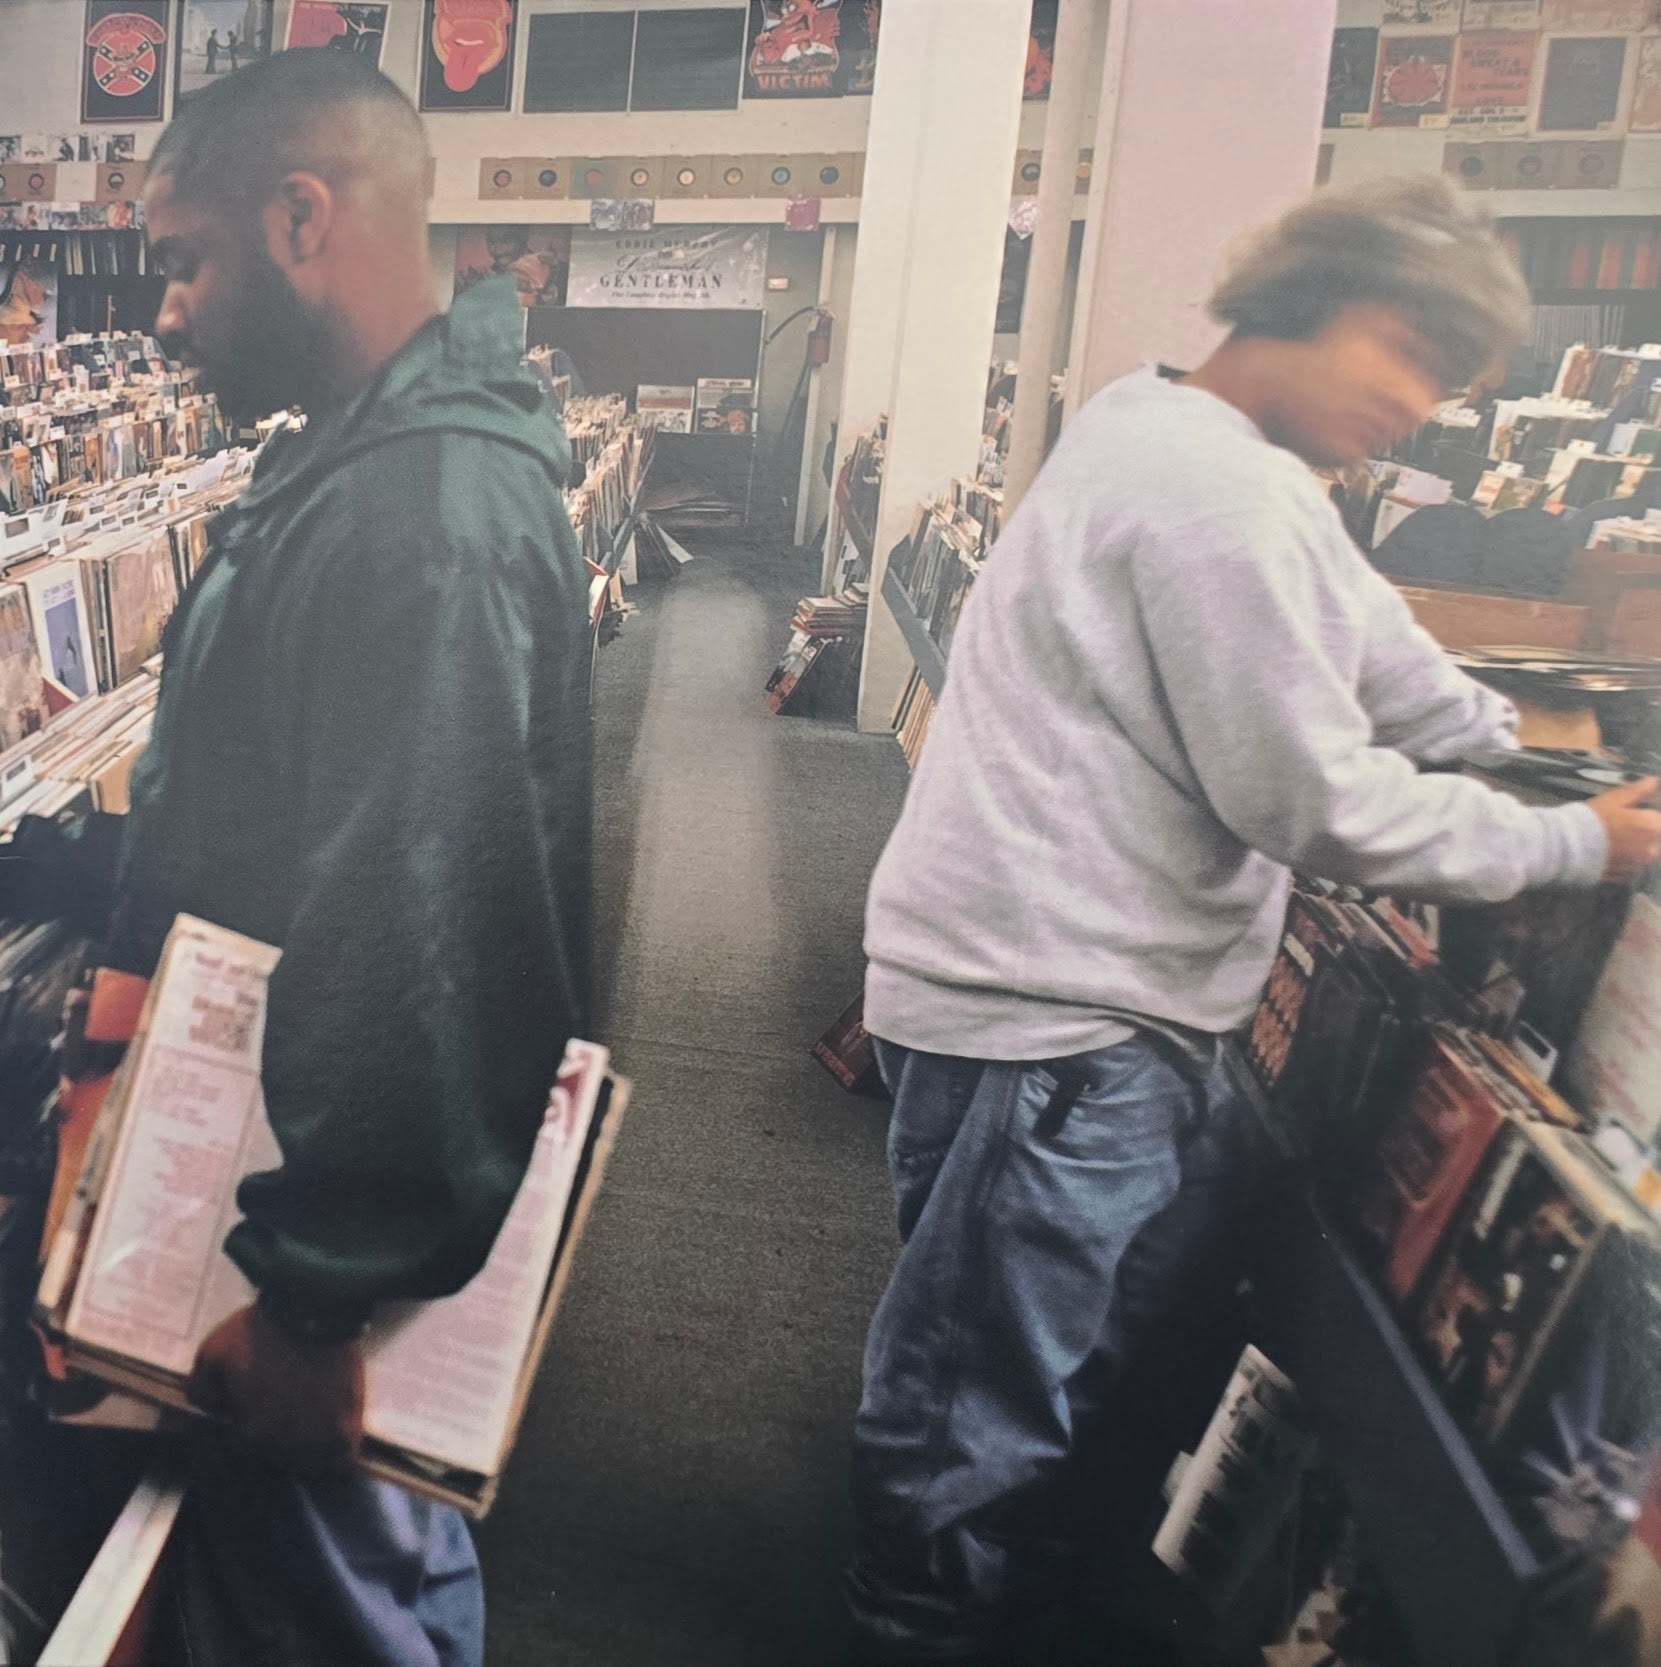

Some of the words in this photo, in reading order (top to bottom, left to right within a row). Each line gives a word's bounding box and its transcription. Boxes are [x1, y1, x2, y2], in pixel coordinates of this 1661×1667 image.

[757, 73, 831, 90] VICTIM
[616, 239, 655, 249] EDDIE
[600, 273, 722, 289] GENTLEMAN
